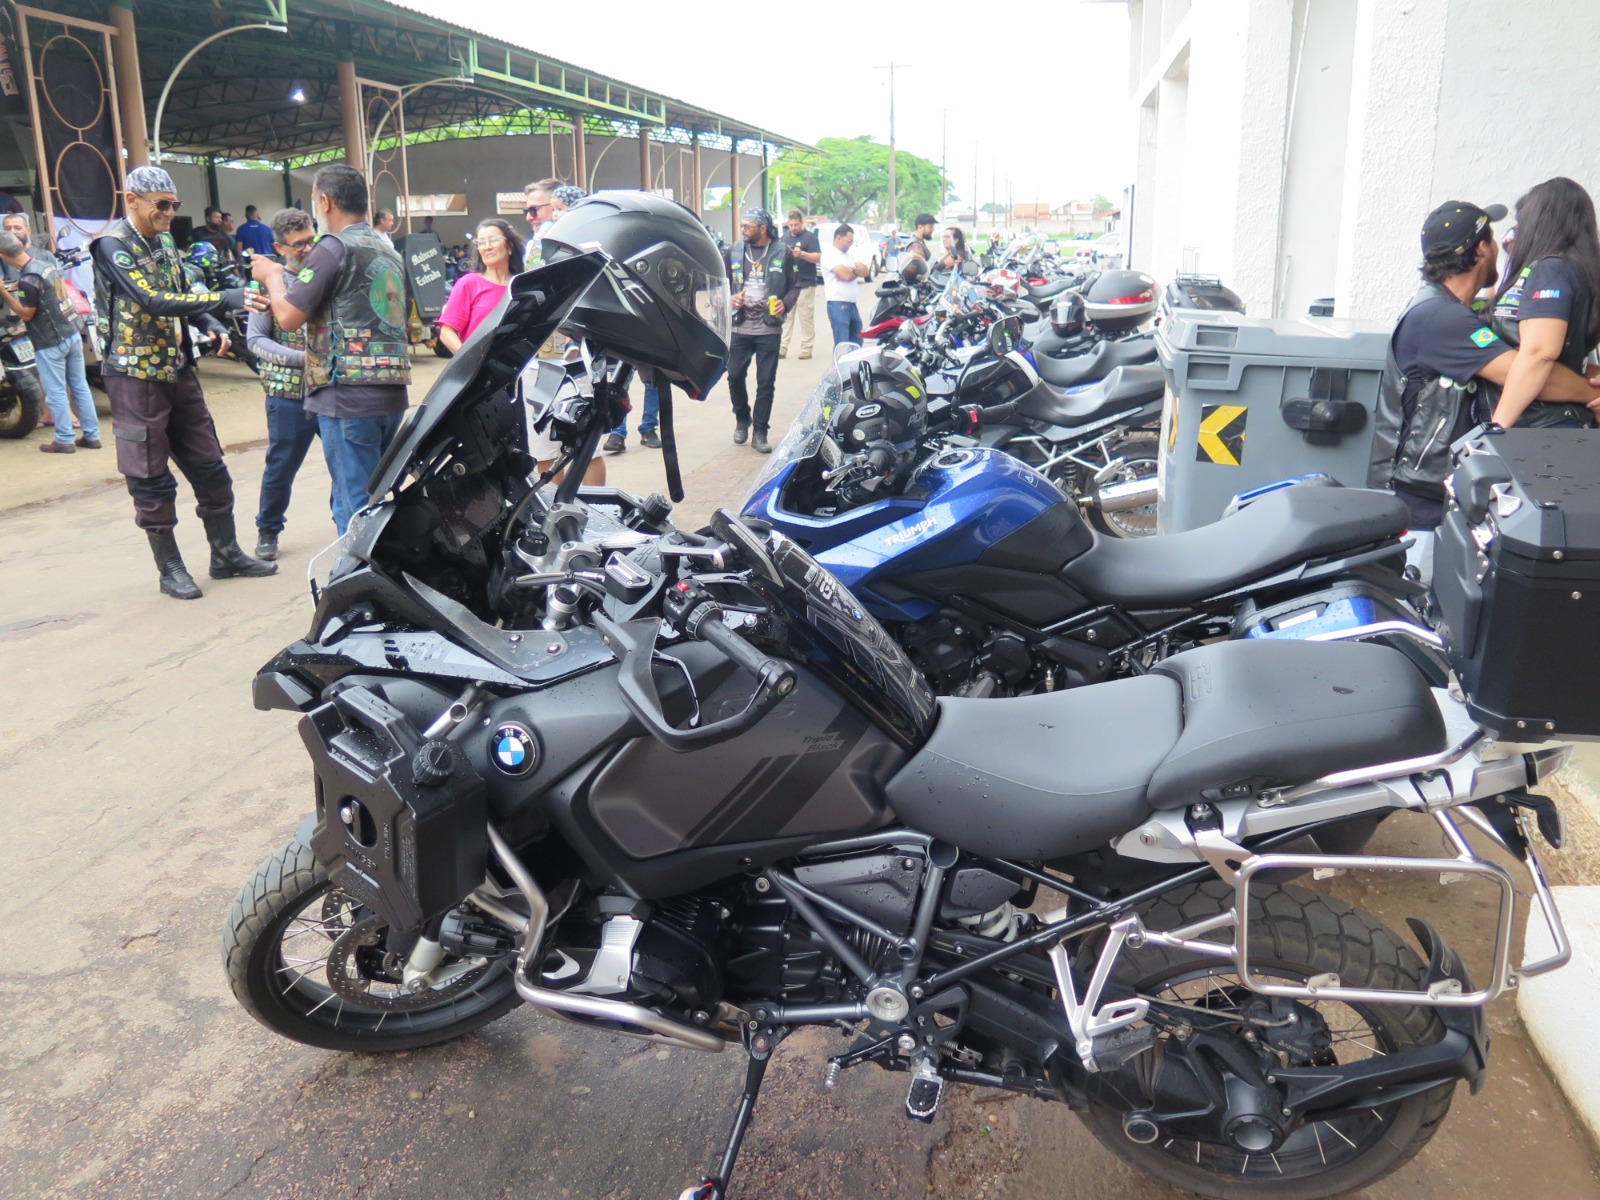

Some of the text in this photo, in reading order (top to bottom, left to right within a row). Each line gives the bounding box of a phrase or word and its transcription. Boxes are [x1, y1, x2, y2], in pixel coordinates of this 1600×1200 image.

[415, 270, 441, 287] Estrada
[163, 293, 221, 302] CLUBE
[1531, 289, 1561, 299] AMM
[884, 516, 938, 547] TRIUMPH
[493, 728, 530, 744] BMW
[803, 734, 835, 744] Triple
[808, 741, 839, 751] Black
